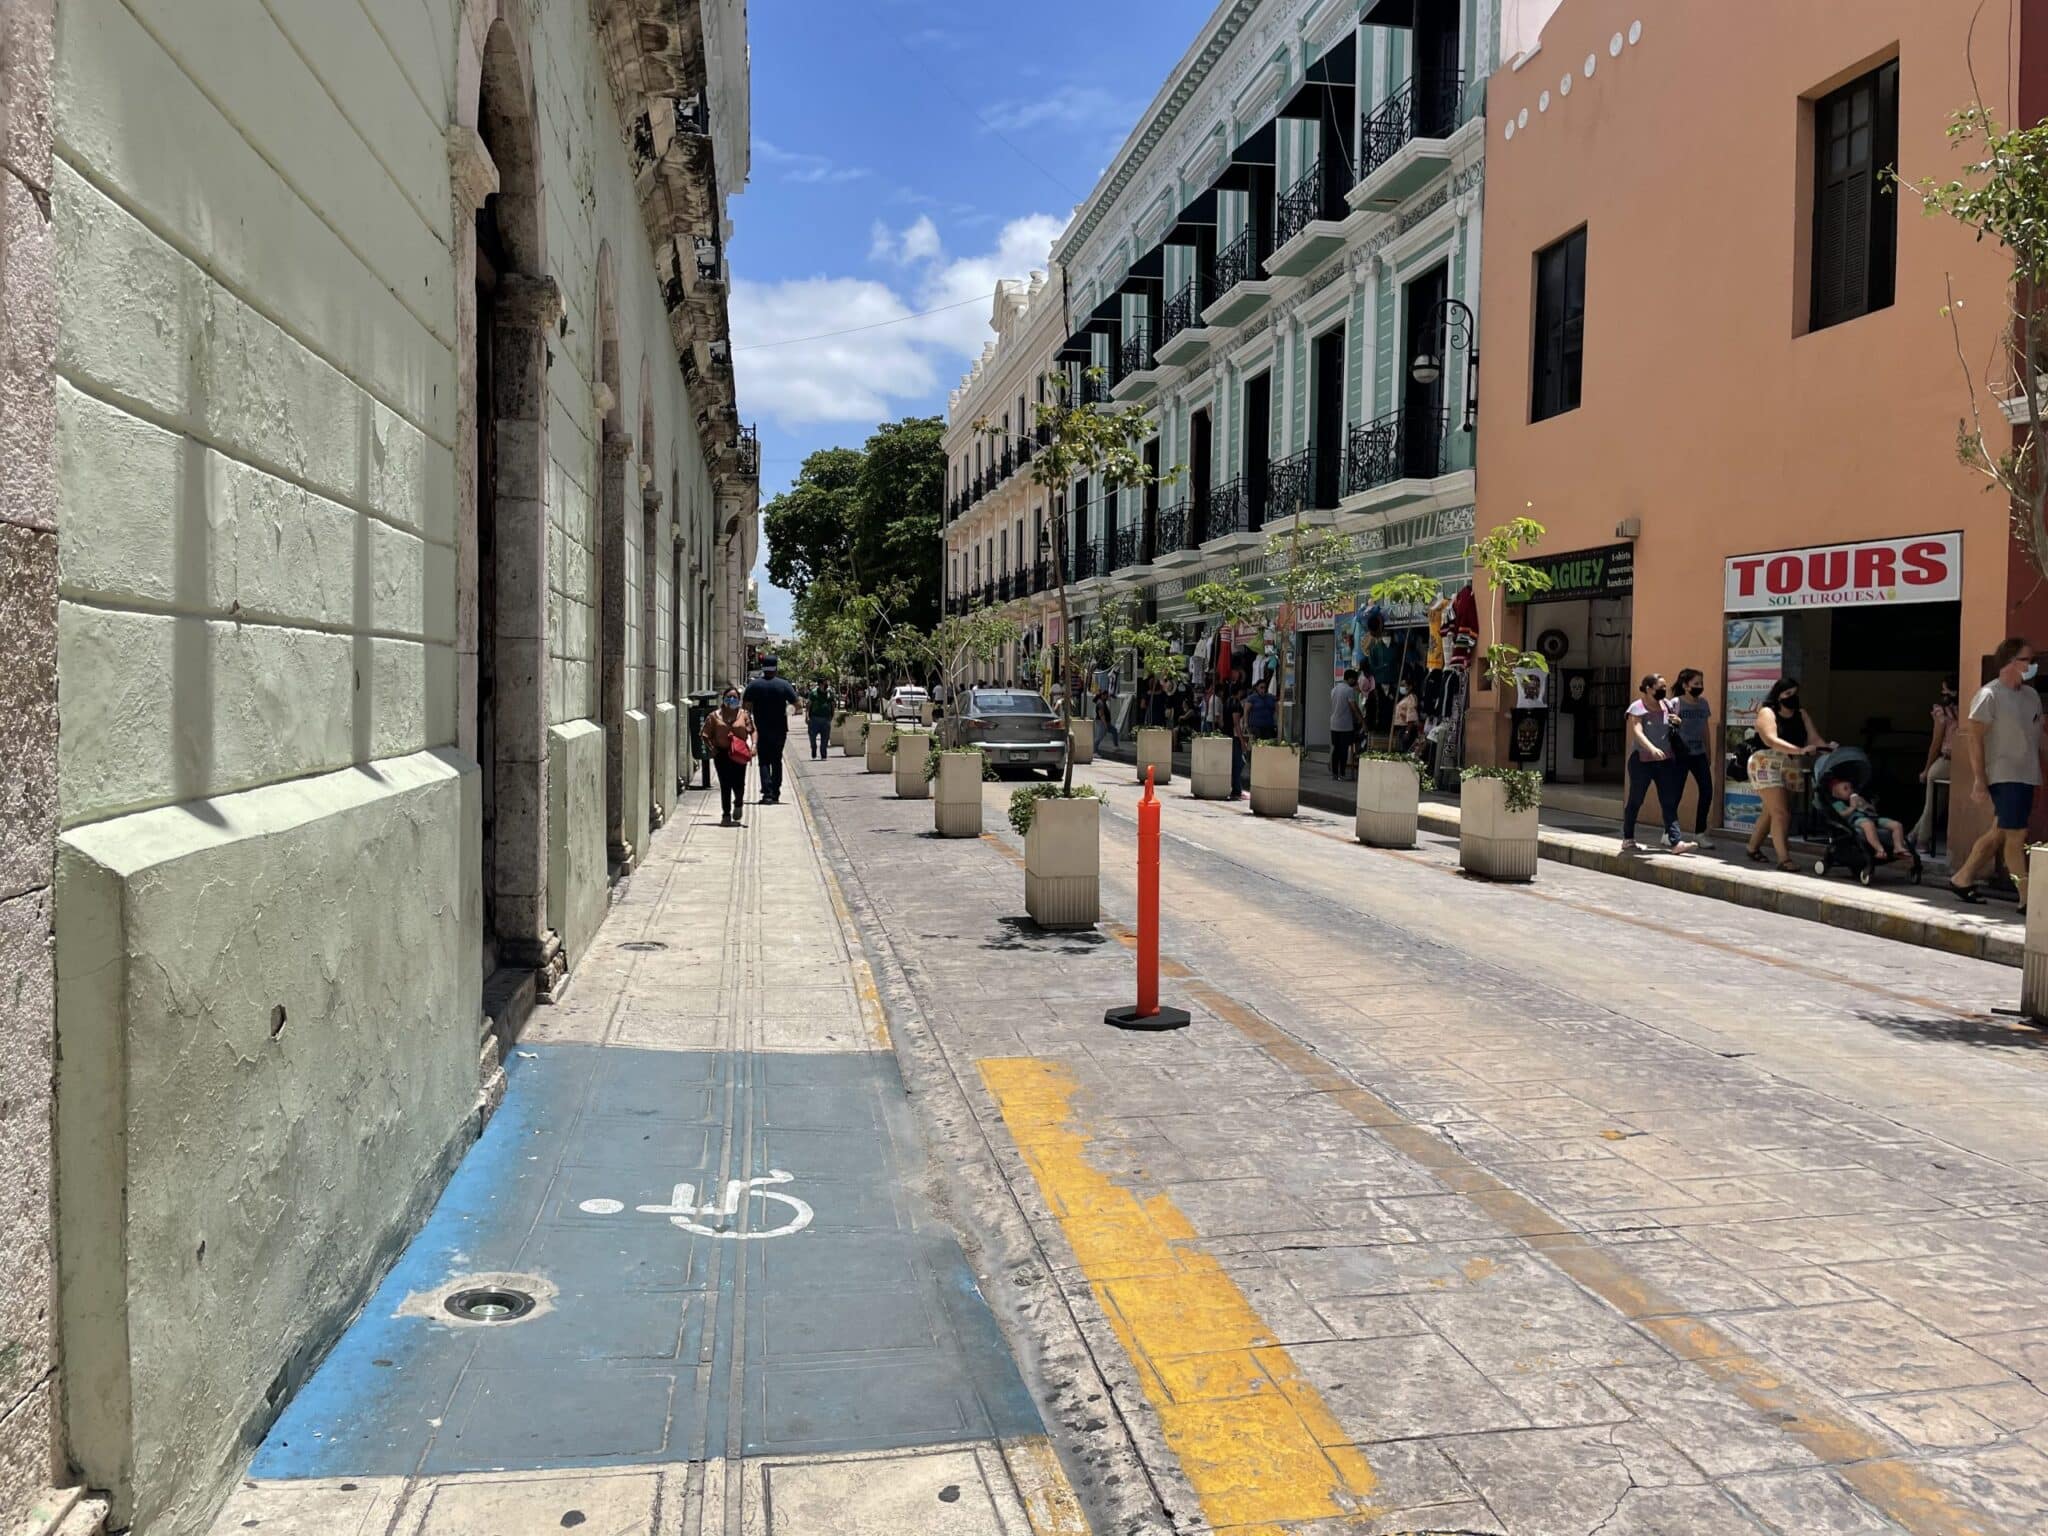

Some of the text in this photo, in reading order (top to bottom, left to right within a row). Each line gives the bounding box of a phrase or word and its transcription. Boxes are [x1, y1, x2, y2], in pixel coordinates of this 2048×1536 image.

[1536, 558, 1604, 589] AGUEY
[1732, 541, 1948, 597] TOURS
[1768, 590, 1886, 606] SOL TURQUESA
